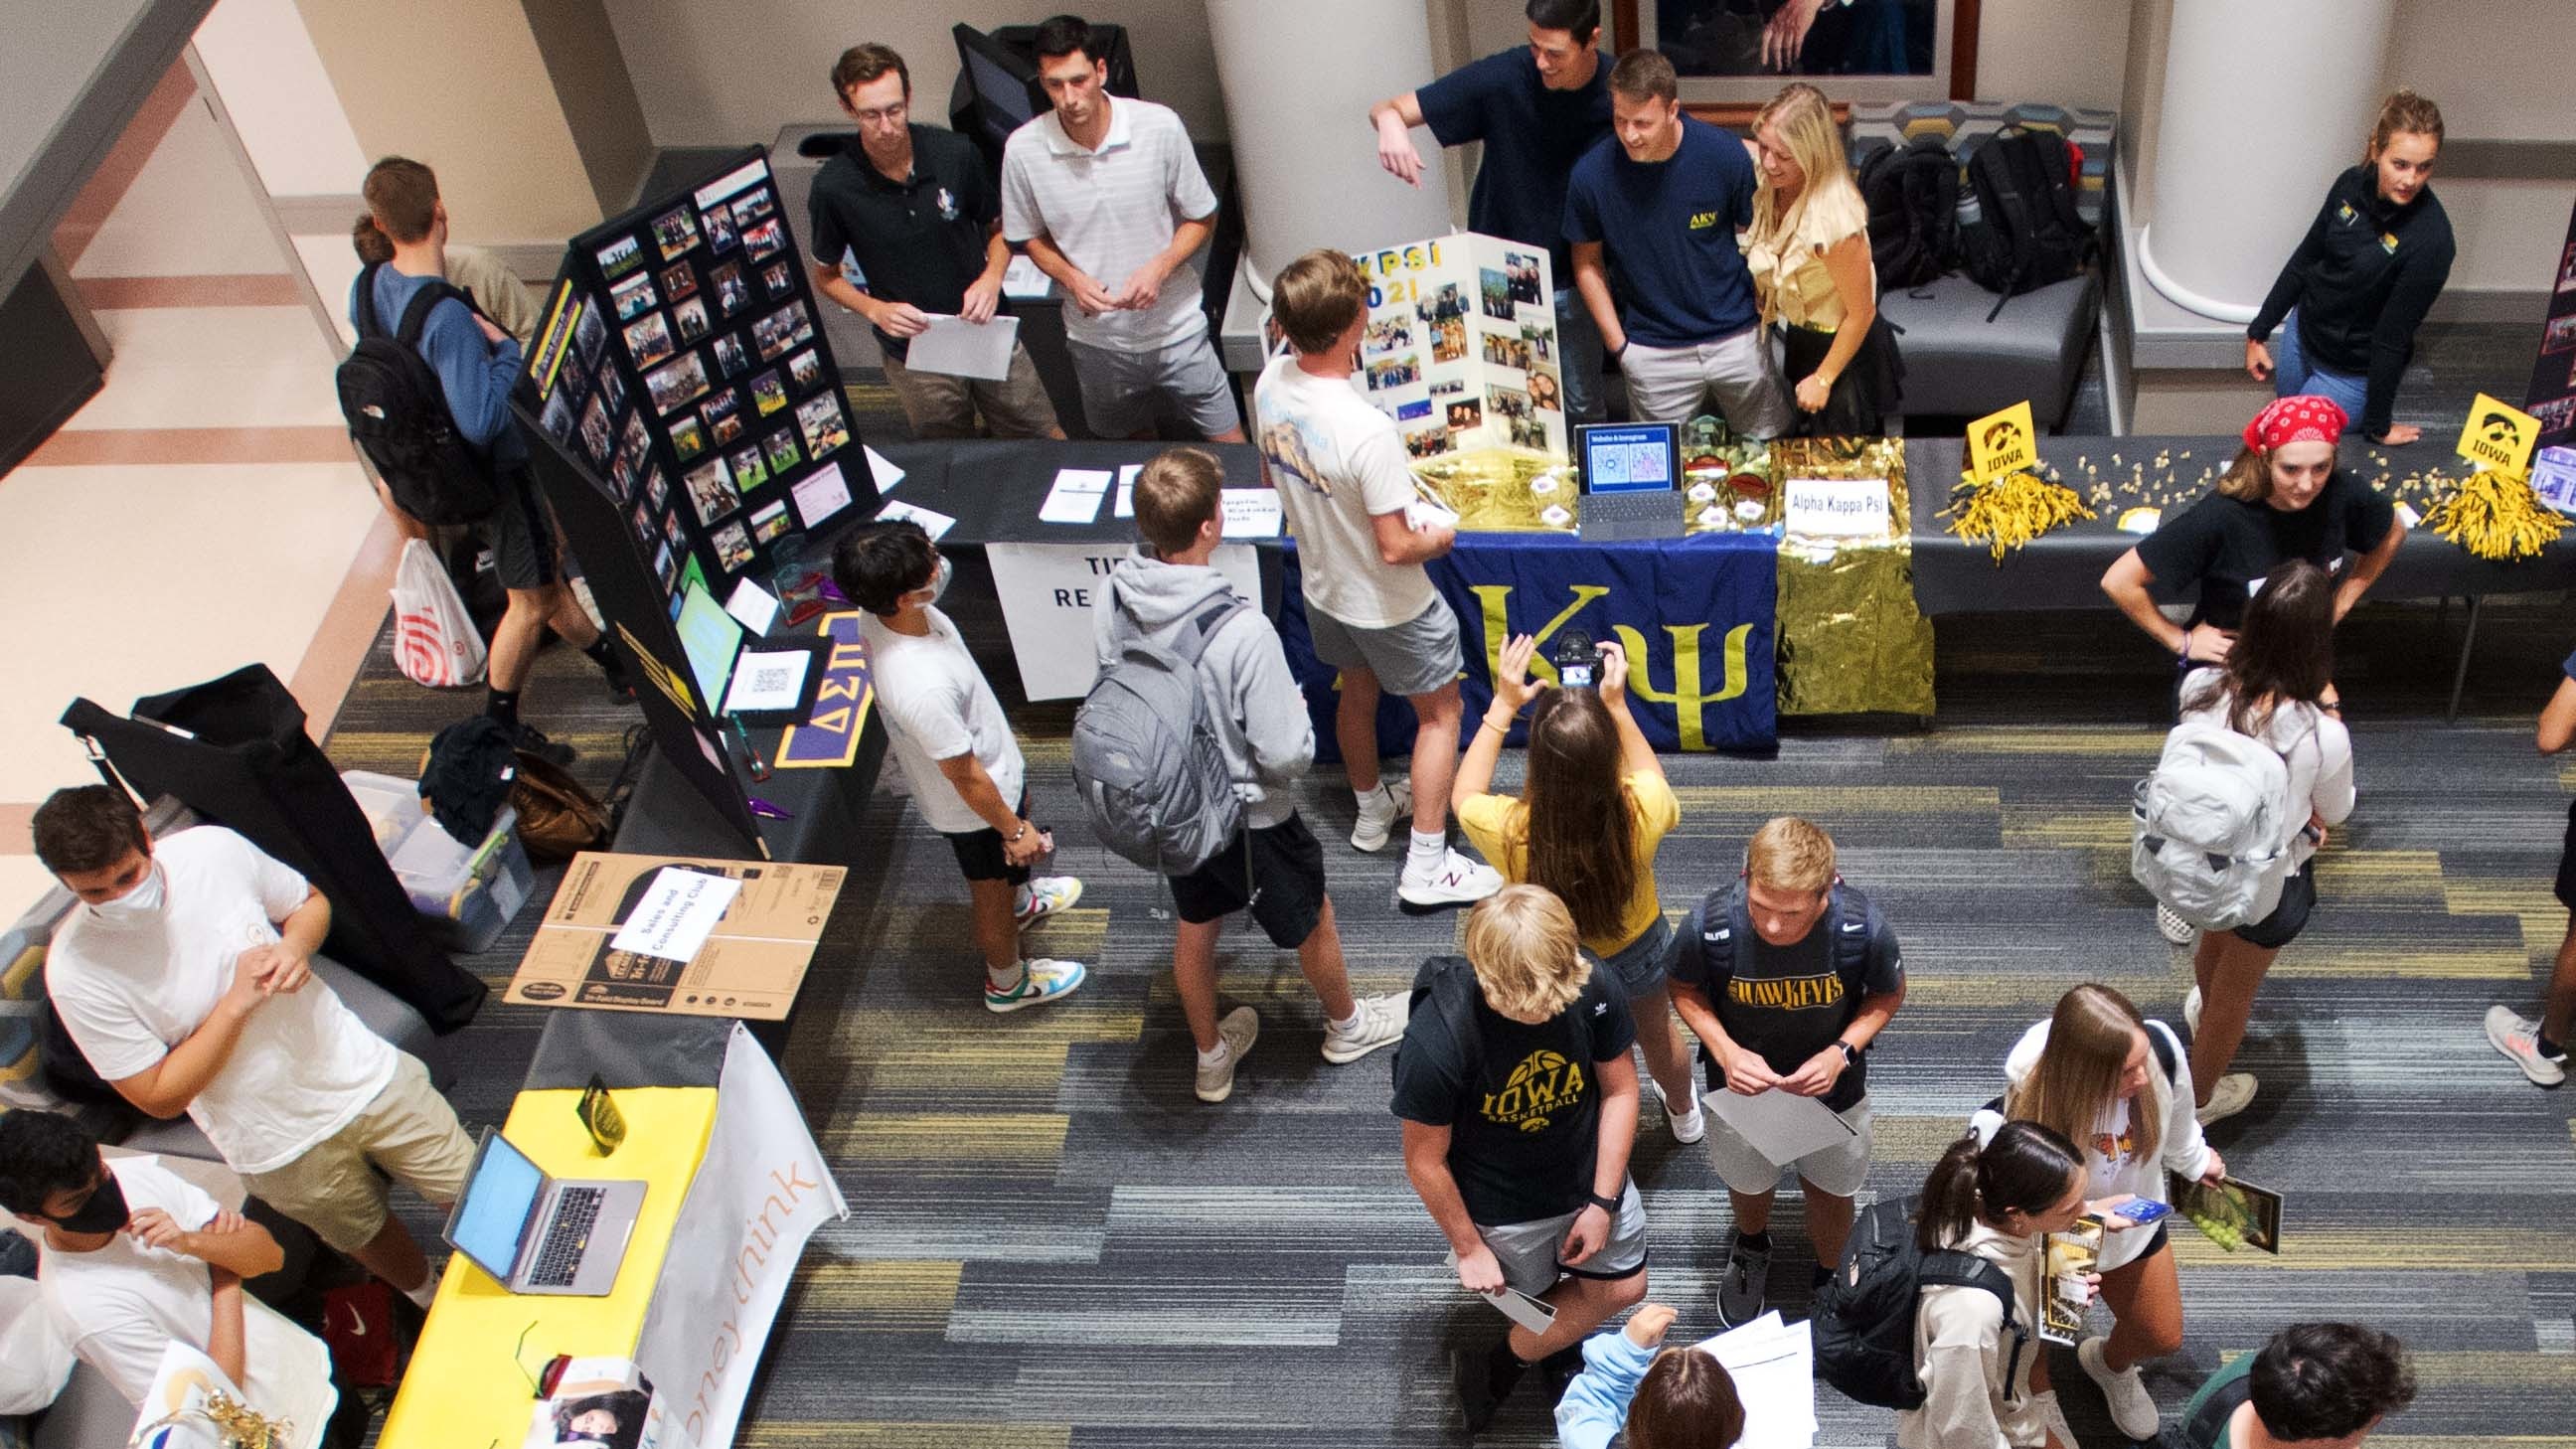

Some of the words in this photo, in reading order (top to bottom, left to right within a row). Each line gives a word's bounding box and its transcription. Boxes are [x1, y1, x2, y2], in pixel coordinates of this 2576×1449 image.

[1988, 448, 2023, 473] IOWA
[2473, 438, 2512, 467] IOWA
[1793, 494, 1825, 514] Alpha
[1828, 495, 1863, 515] Kappa
[1866, 496, 1884, 513] Psi
[641, 908, 666, 935] Sales
[663, 888, 679, 907] and
[652, 900, 695, 951] Consulting
[687, 878, 708, 899] Club
[1737, 969, 1845, 1012] HAWKEYES
[1480, 1061, 1585, 1115] IOWA
[1488, 1094, 1579, 1123] BASKETBALL
